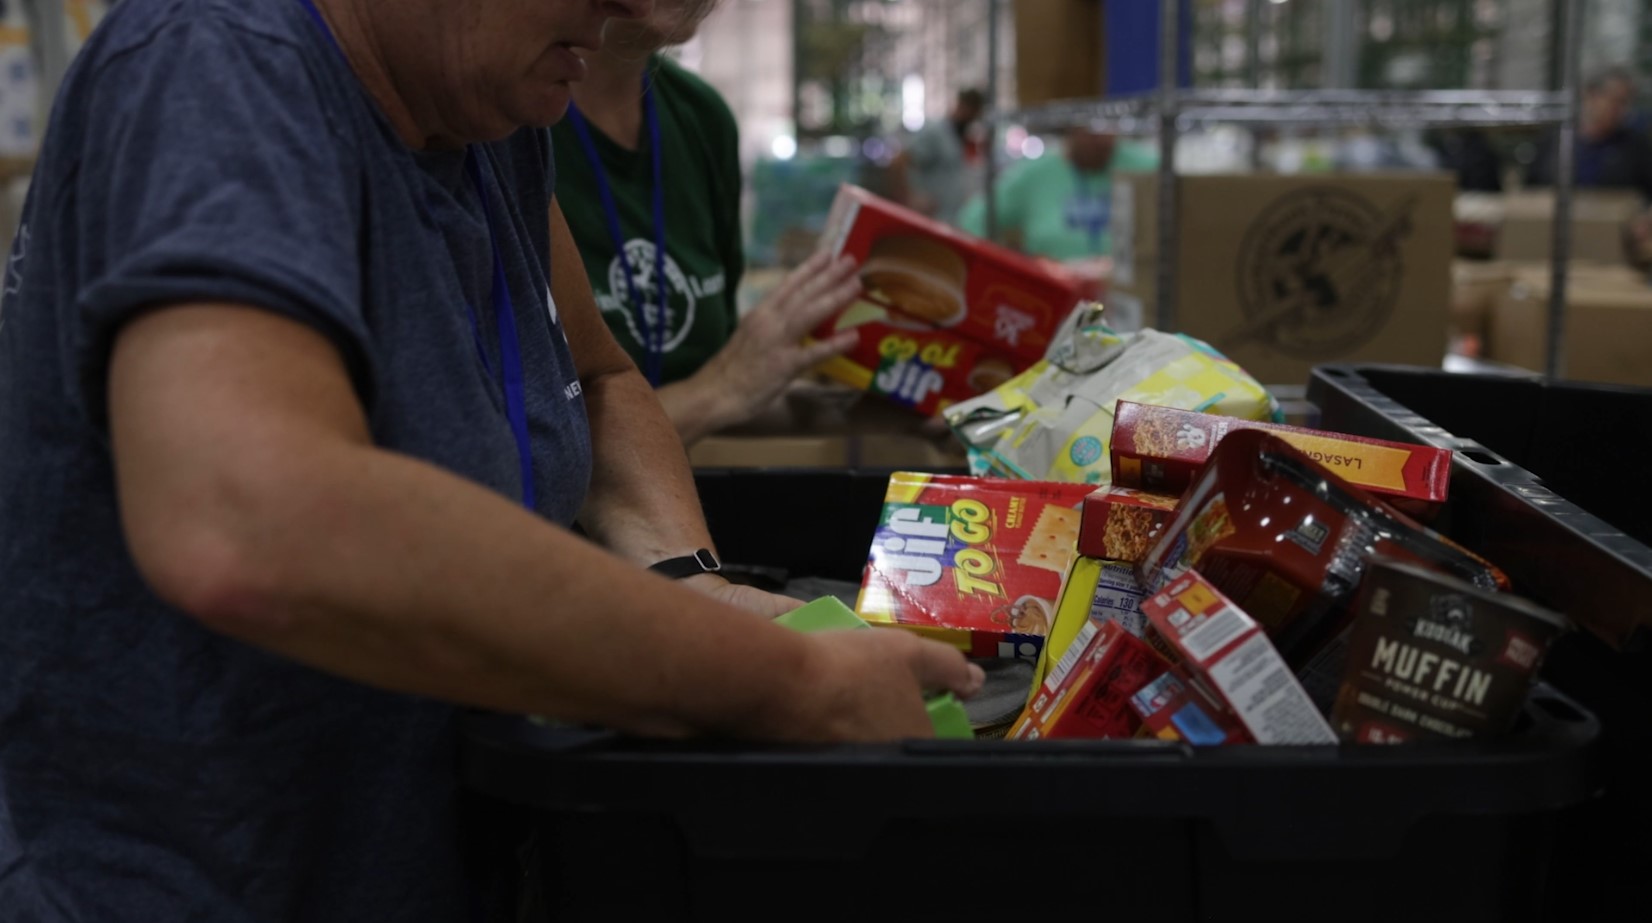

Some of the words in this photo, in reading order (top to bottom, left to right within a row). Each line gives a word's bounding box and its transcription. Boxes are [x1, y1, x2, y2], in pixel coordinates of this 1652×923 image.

[950, 498, 991, 545] GO
[954, 548, 1001, 596] TO
[1119, 597, 1134, 609] 130
[1371, 635, 1493, 706] MUFFIN
